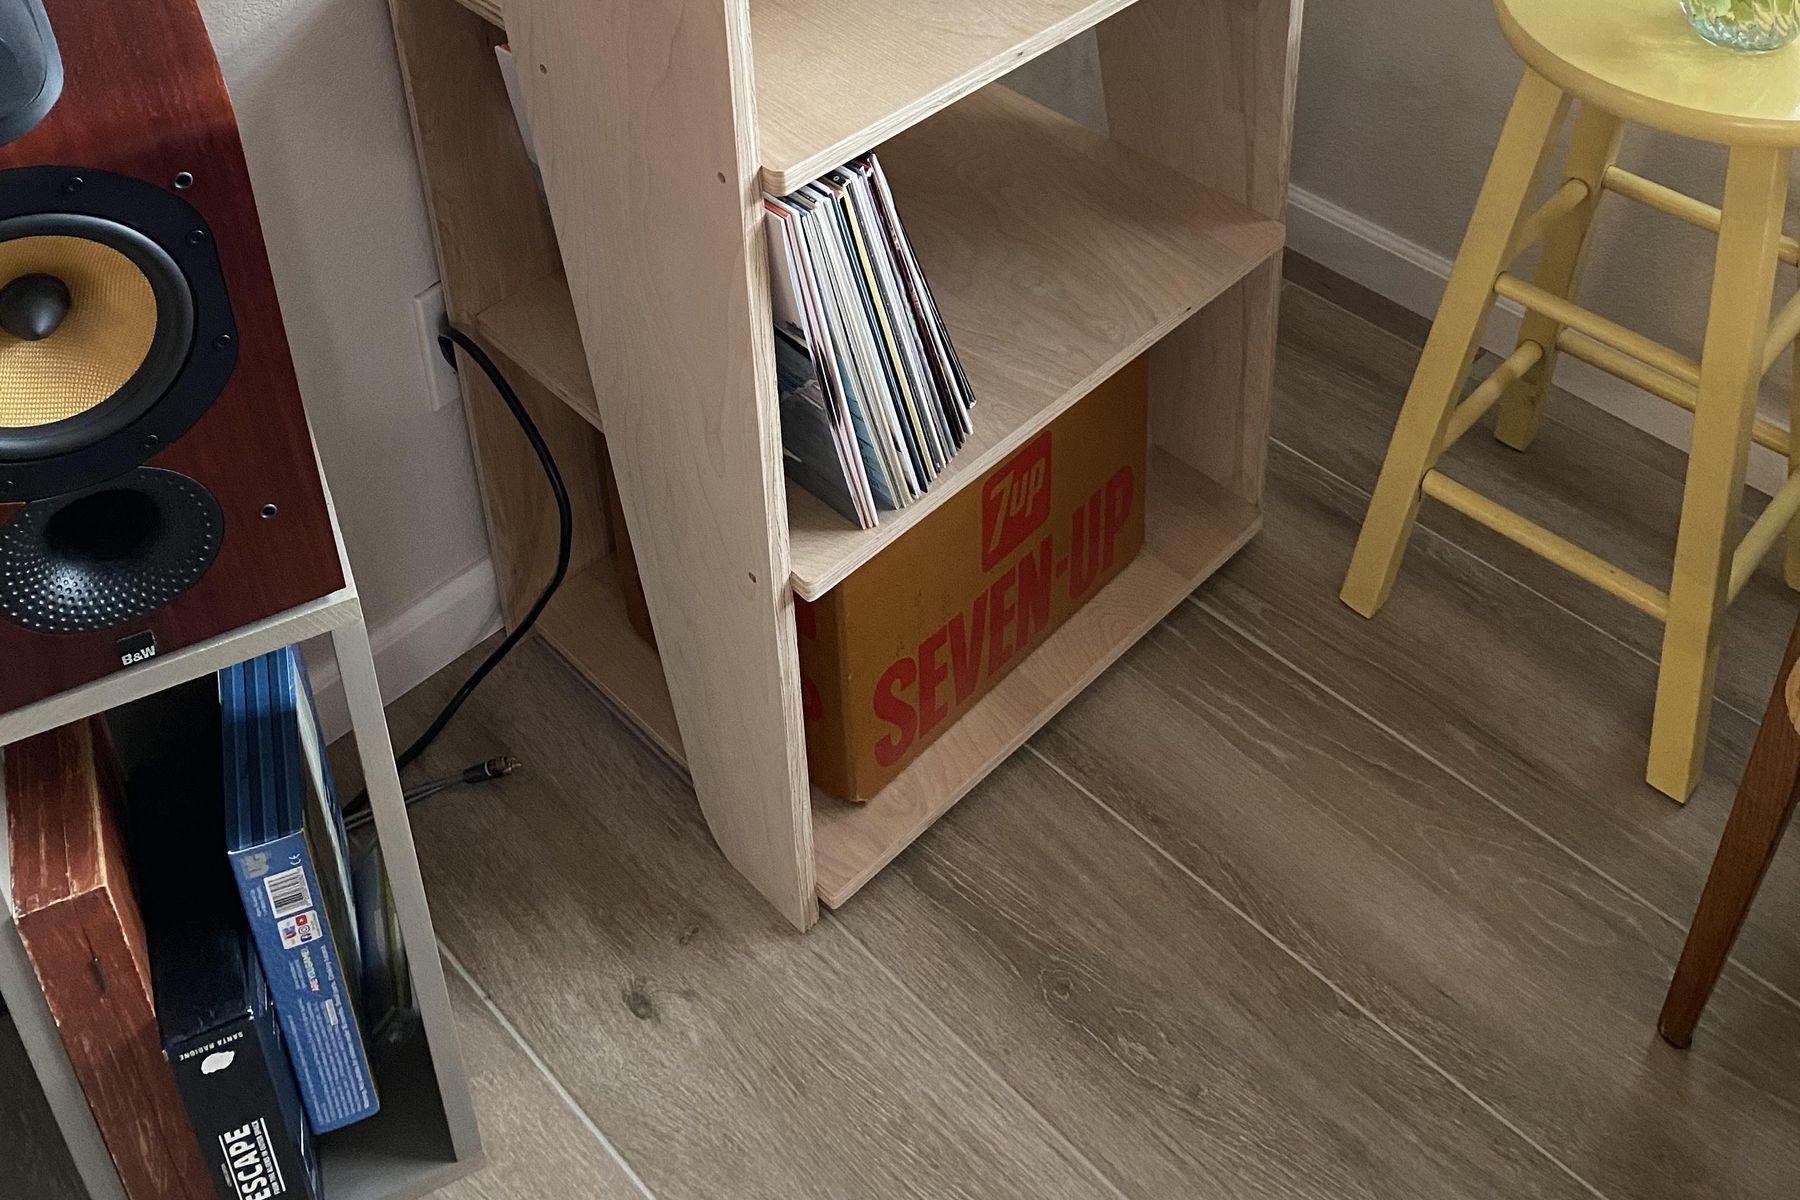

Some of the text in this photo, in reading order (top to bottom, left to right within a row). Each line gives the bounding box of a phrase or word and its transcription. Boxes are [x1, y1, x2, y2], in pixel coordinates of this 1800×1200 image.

[873, 465, 1135, 768] SEVEN-UP
[121, 645, 156, 666] B&W
[217, 1031, 244, 1047] SANTA
[223, 1123, 272, 1200] ESCAPE
